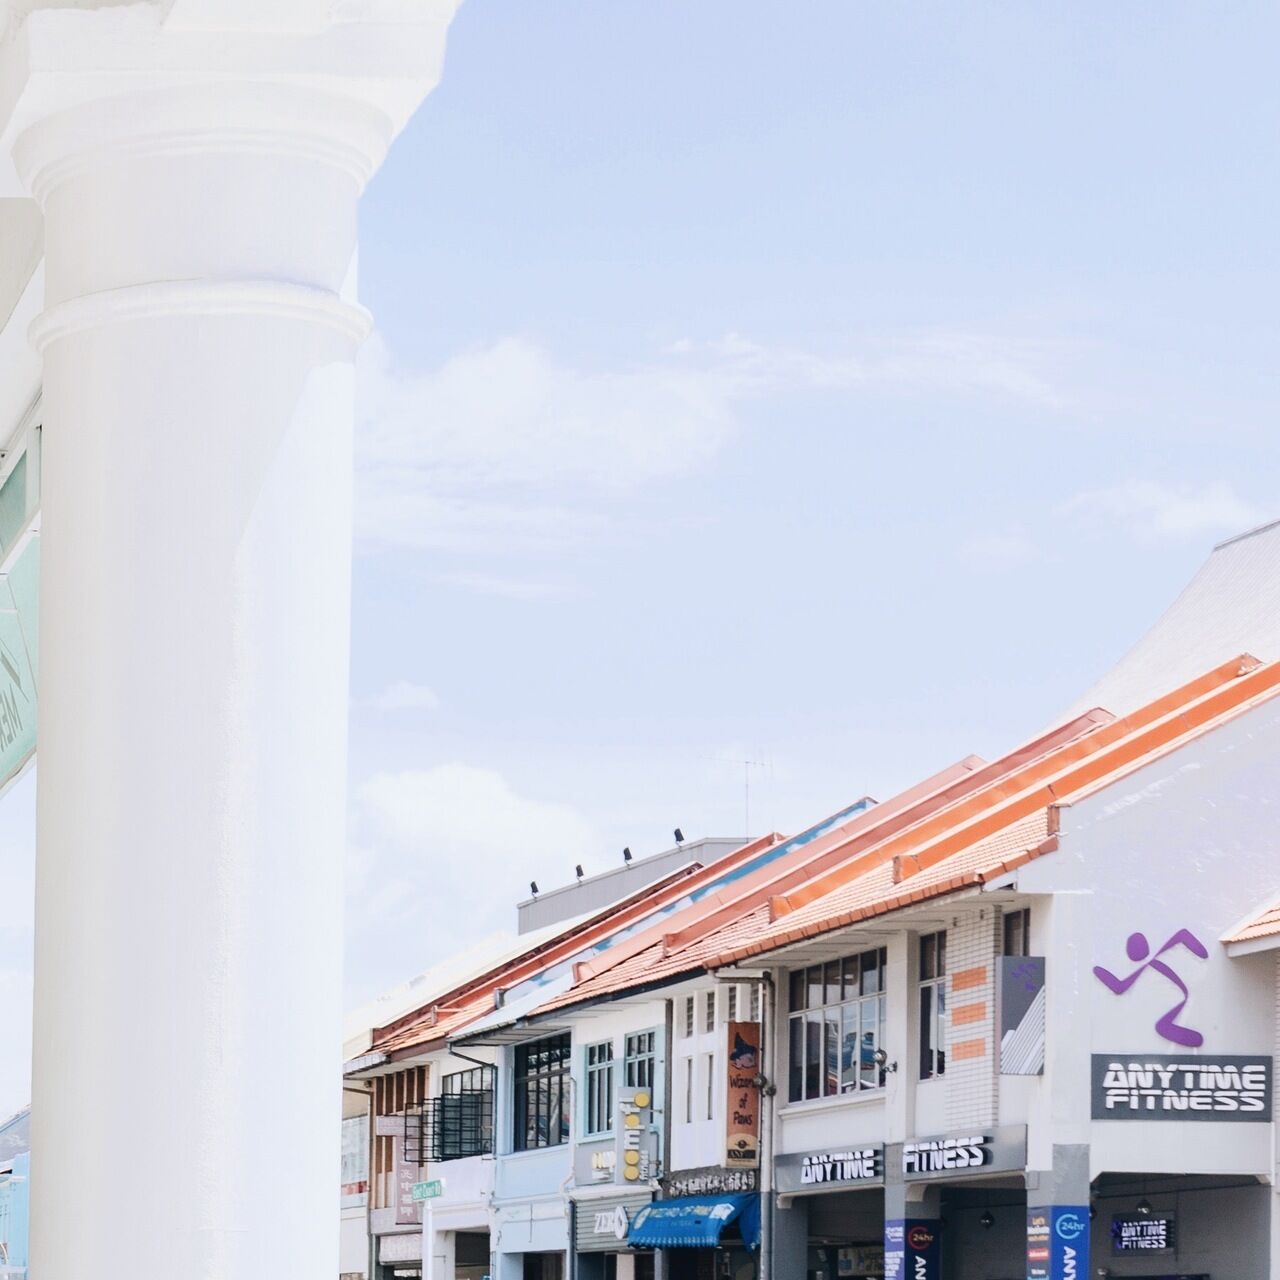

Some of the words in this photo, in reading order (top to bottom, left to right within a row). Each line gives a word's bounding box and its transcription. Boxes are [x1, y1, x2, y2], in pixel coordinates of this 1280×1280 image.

[729, 1073, 757, 1089] Wizar
[1102, 1062, 1267, 1091] ANYTIME
[738, 1092, 748, 1110] of
[1105, 1089, 1266, 1113] FITNESS
[733, 1111, 753, 1126] Paws
[800, 1148, 877, 1185] ANYTIME
[902, 1136, 986, 1175] FITNESS
[1061, 1220, 1086, 1232] 24hr
[1121, 1219, 1167, 1237] ANYTIME
[912, 1232, 935, 1243] 24hr
[1121, 1236, 1167, 1249] FITNESS
